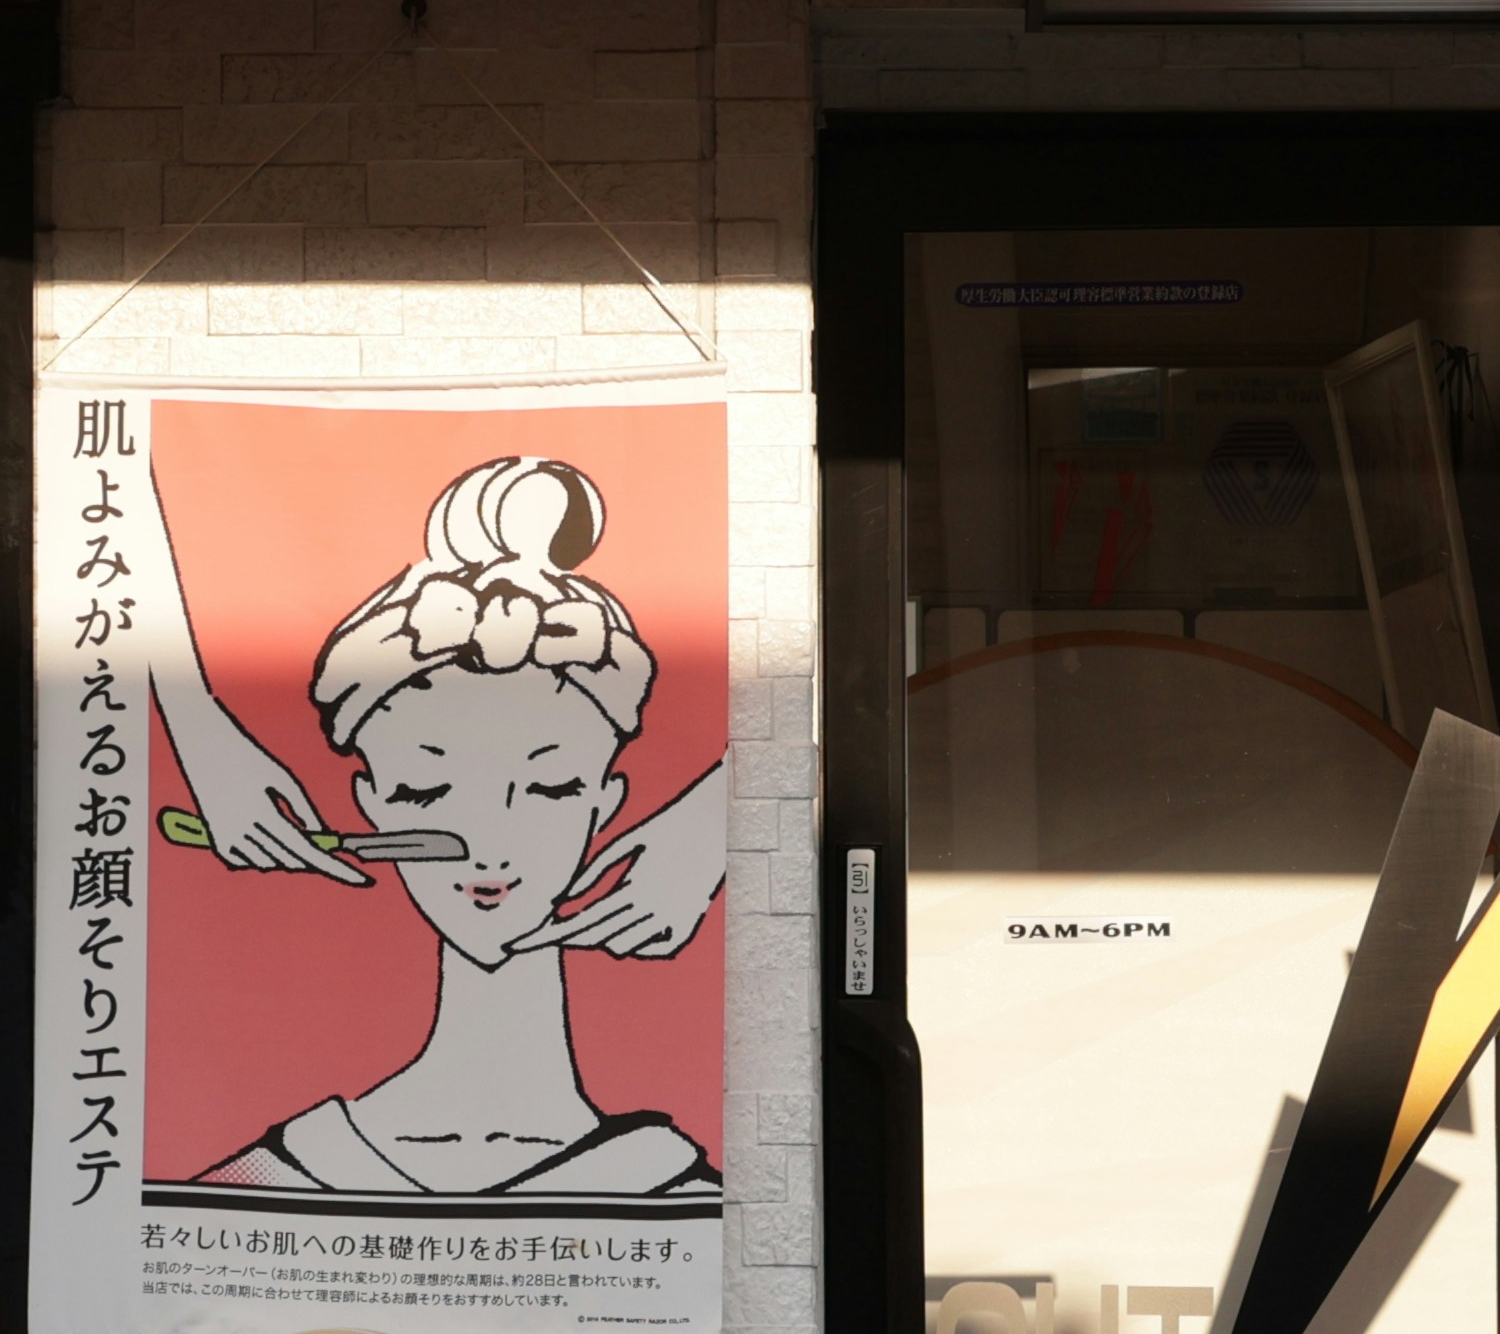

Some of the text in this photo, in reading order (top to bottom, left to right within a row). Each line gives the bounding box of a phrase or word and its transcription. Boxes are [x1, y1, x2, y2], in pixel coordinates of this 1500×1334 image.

[69, 397, 137, 1207] 肌よみがえるお顔そりエステ
[850, 905, 869, 992] いらっしゃいませ
[139, 1222, 696, 1265] 若々しいお肌への基礎作りをお手伝いします。
[141, 1280, 569, 1309] 当店では、この周期に合わせて理容師によるお顔そりをおすすめしています。
